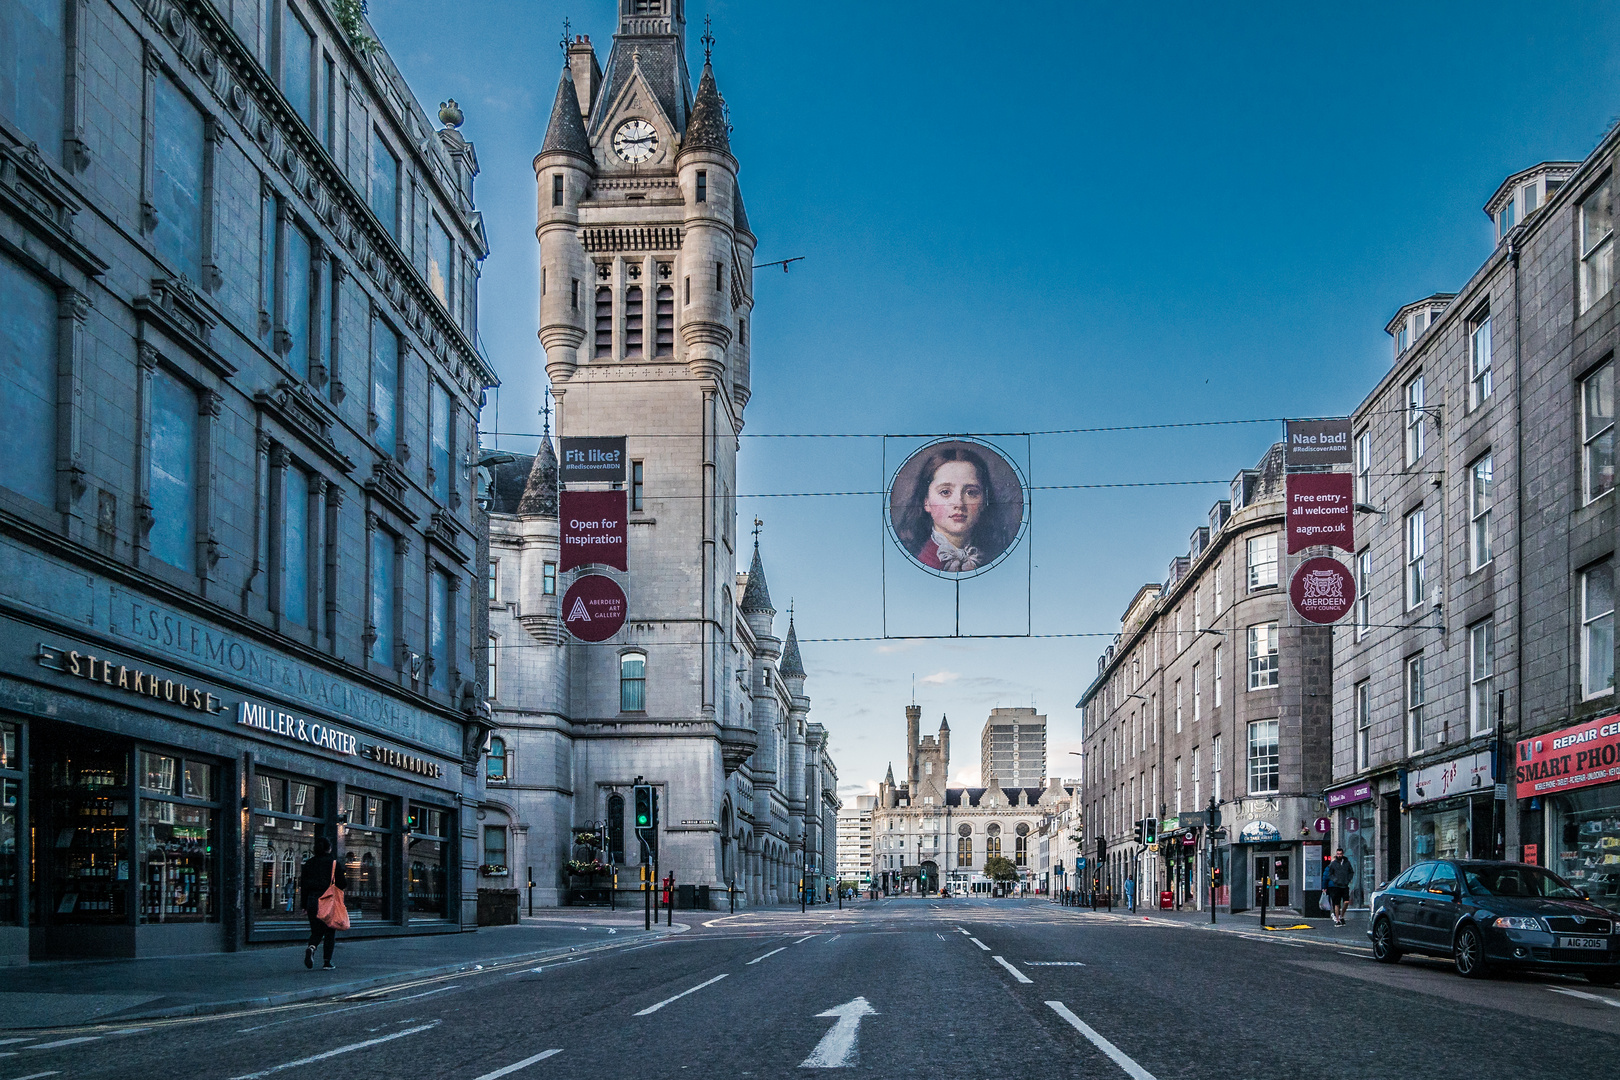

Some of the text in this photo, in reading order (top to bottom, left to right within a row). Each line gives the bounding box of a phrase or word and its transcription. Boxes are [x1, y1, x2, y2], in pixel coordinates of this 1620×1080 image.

[1292, 432, 1347, 444] Nae bad!
[566, 449, 621, 462] Fit like?
[1294, 493, 1315, 502] Free
[1316, 494, 1341, 503] entry
[1292, 505, 1348, 515] all welcome!
[570, 518, 618, 531] Open for
[1296, 523, 1346, 535] aagm.co.uk
[565, 533, 622, 547] inspiration
[1301, 598, 1346, 606] ABERDEEN
[131, 602, 400, 728] ESSLEMONT & MACINTOSH
[70, 650, 213, 712] STEAKHOUSE
[243, 701, 358, 756] MILLER & CARTER
[1553, 728, 1598, 750] REPAIR
[375, 745, 440, 779] STEAKHOUSE
[1516, 754, 1572, 784] SMART
[1583, 939, 1601, 948] 2015
